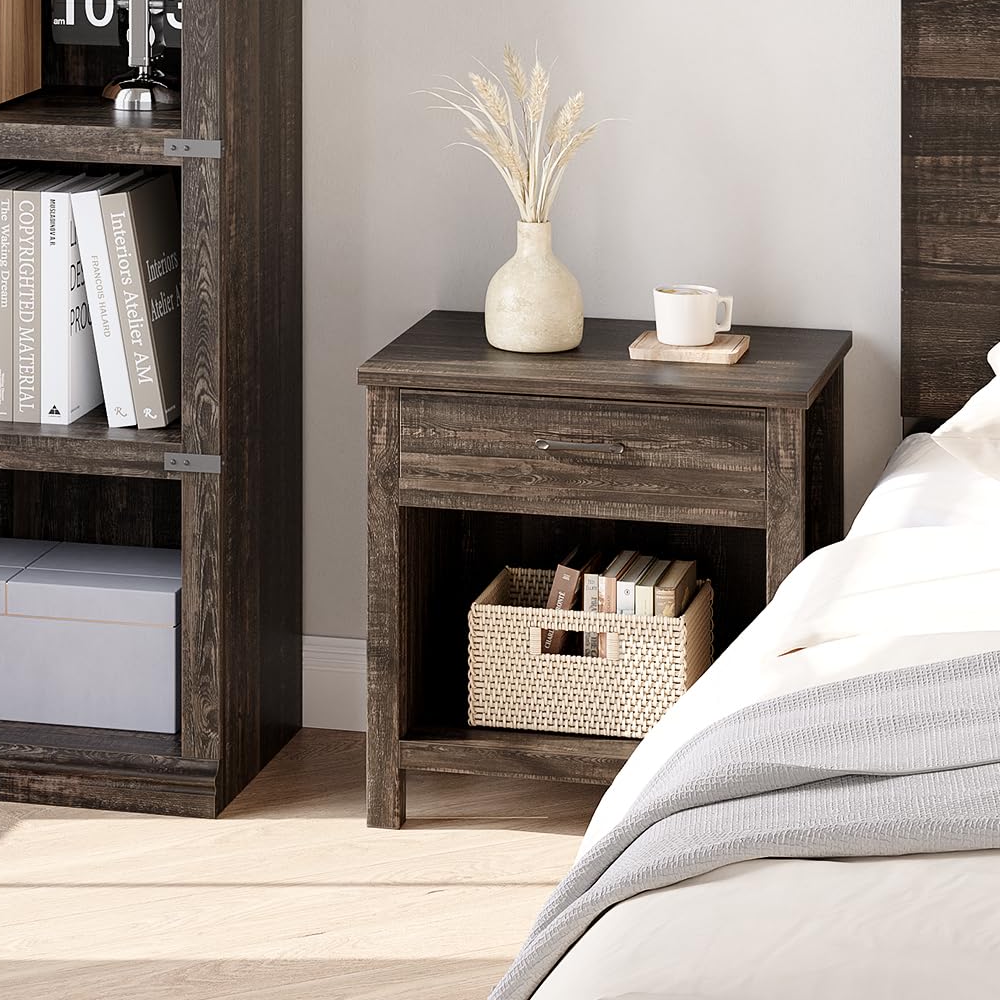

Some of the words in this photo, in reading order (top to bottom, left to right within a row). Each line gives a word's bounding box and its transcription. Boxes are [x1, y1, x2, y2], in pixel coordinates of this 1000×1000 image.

[0, 198, 10, 221] The
[0, 224, 10, 267] Waking
[19, 200, 35, 323] COPYRIGHTED
[110, 211, 132, 286] Interiors
[0, 270, 10, 308] Dream
[145, 252, 179, 283] Interiors
[91, 255, 105, 299] FRANCOIS
[99, 301, 111, 338] HALARD
[123, 290, 144, 346] Atelier
[150, 292, 175, 323] Atelier
[18, 326, 35, 413] MATERIAL
[133, 351, 153, 385] AM
